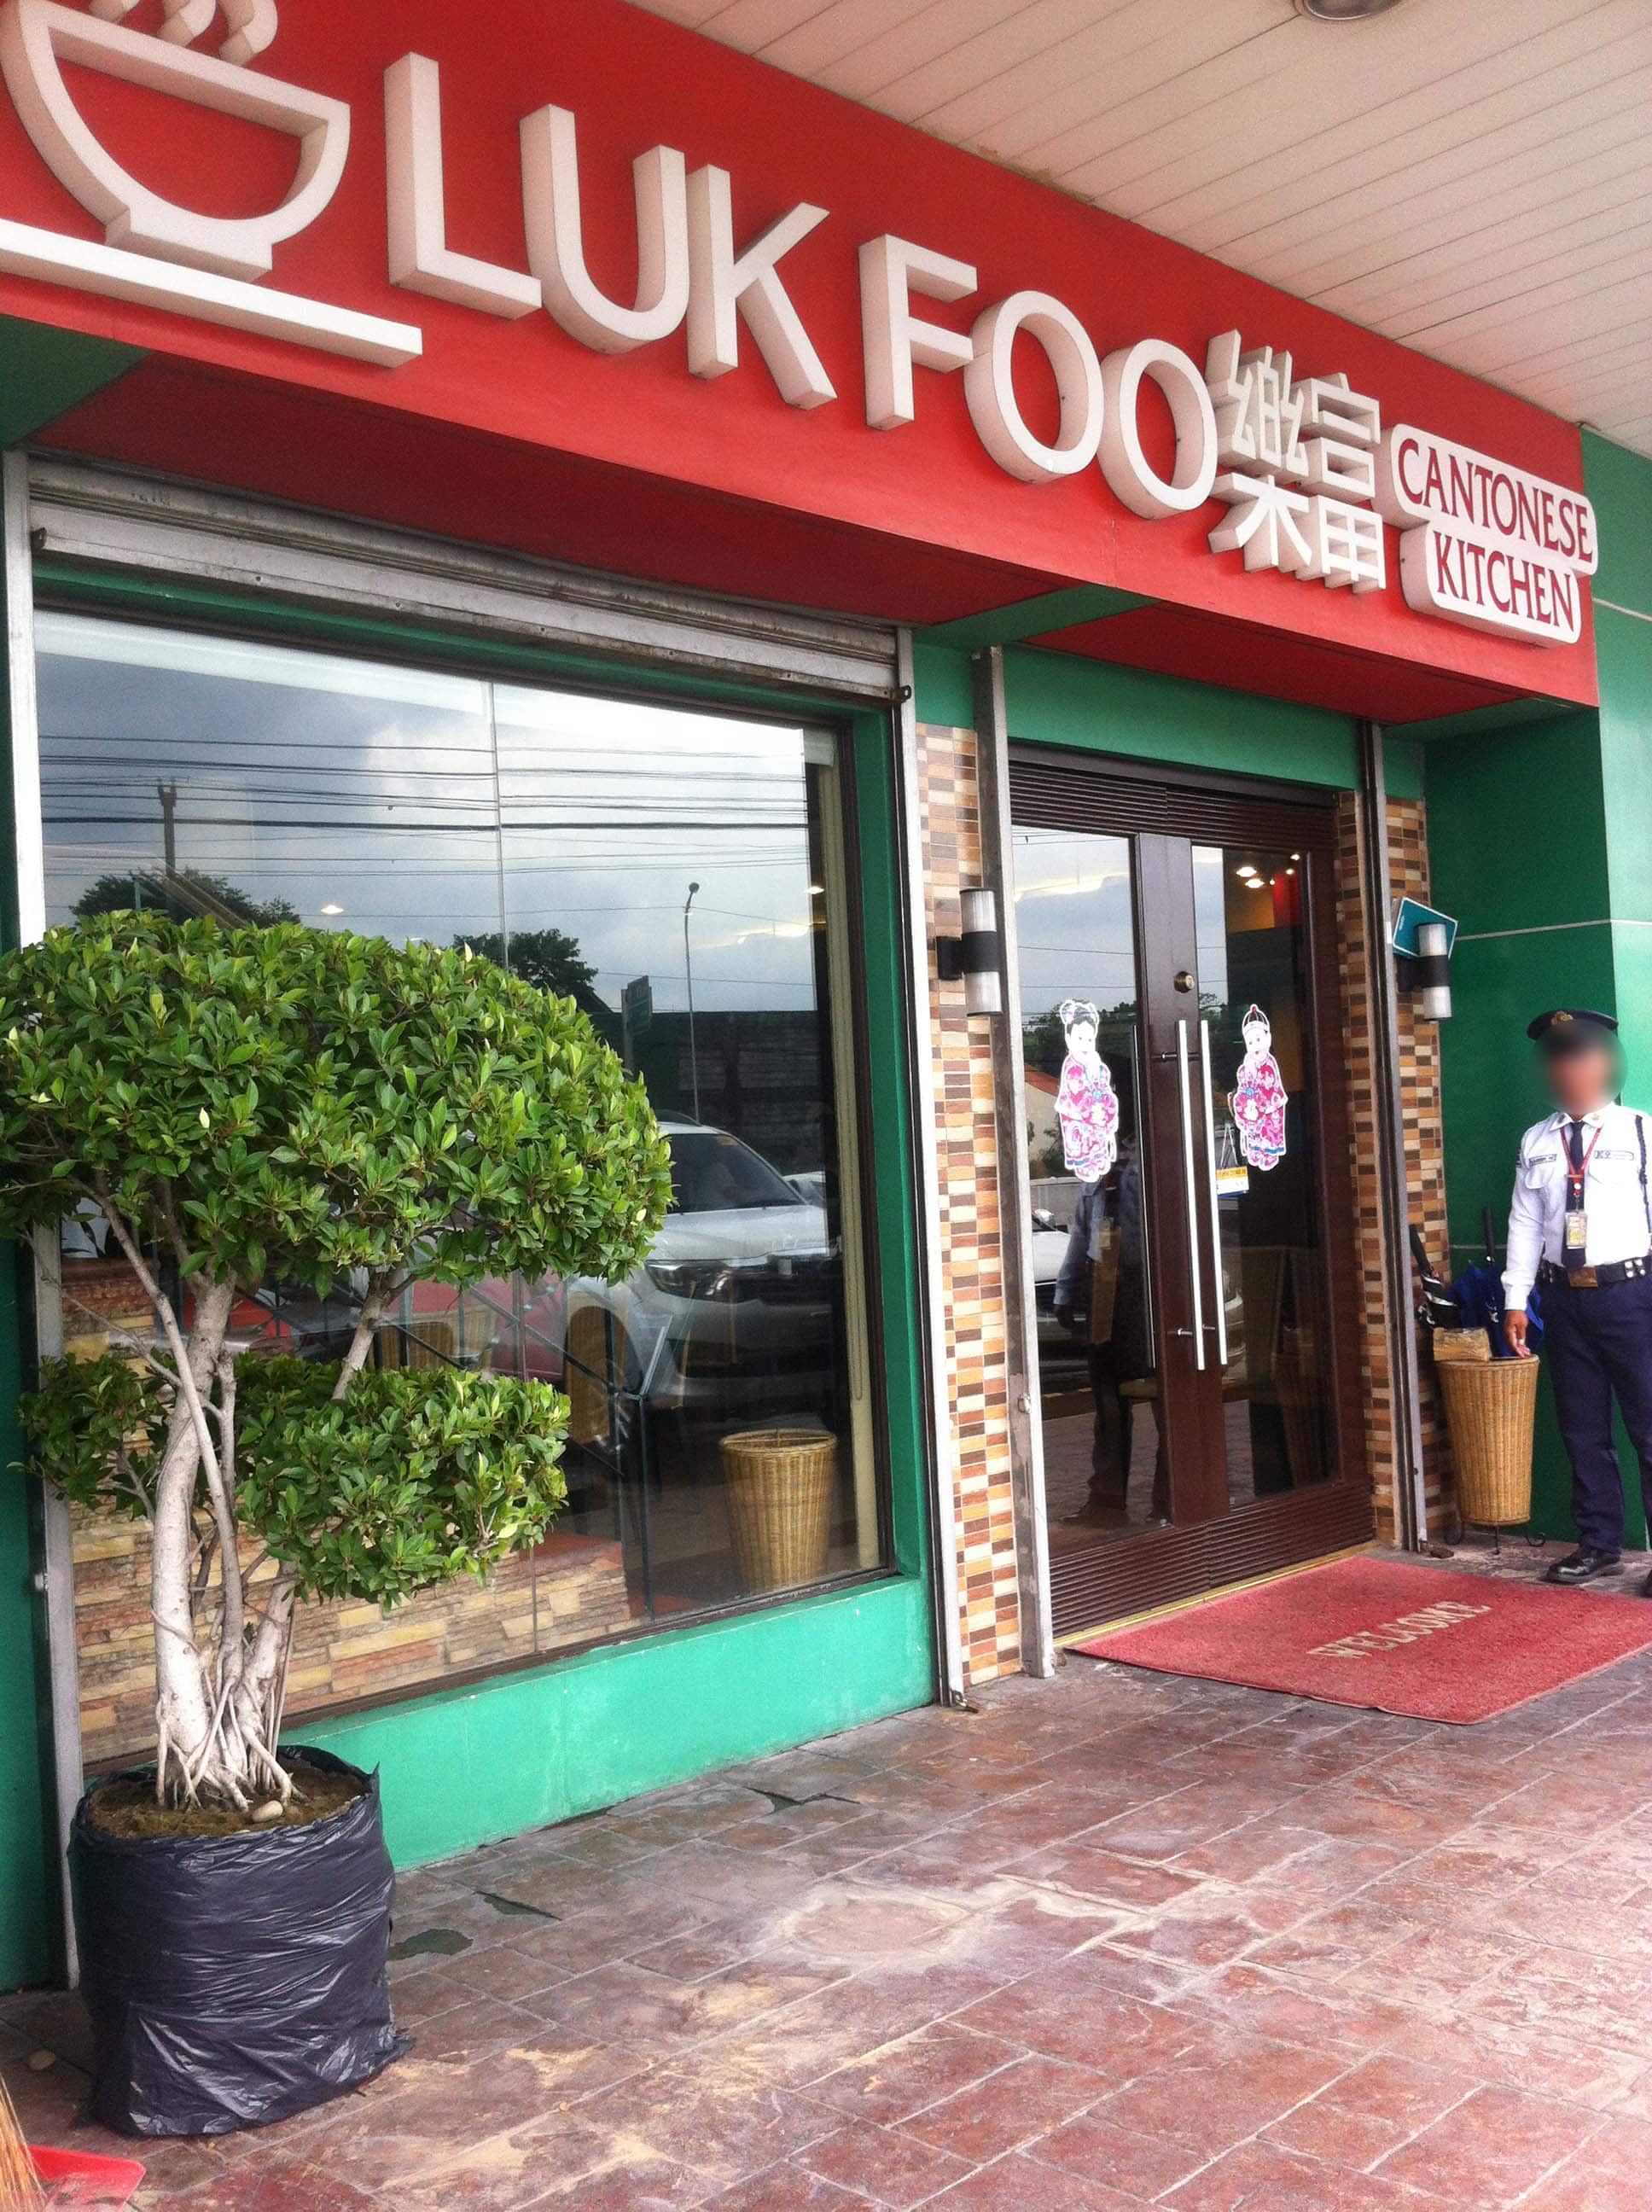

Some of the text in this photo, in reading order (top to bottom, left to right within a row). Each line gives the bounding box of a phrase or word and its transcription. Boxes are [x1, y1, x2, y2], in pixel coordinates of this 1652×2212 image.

[384, 51, 1219, 520] LUK FOO
[1398, 438, 1593, 563] CANTONESE
[1433, 530, 1574, 632] KITCHEN
